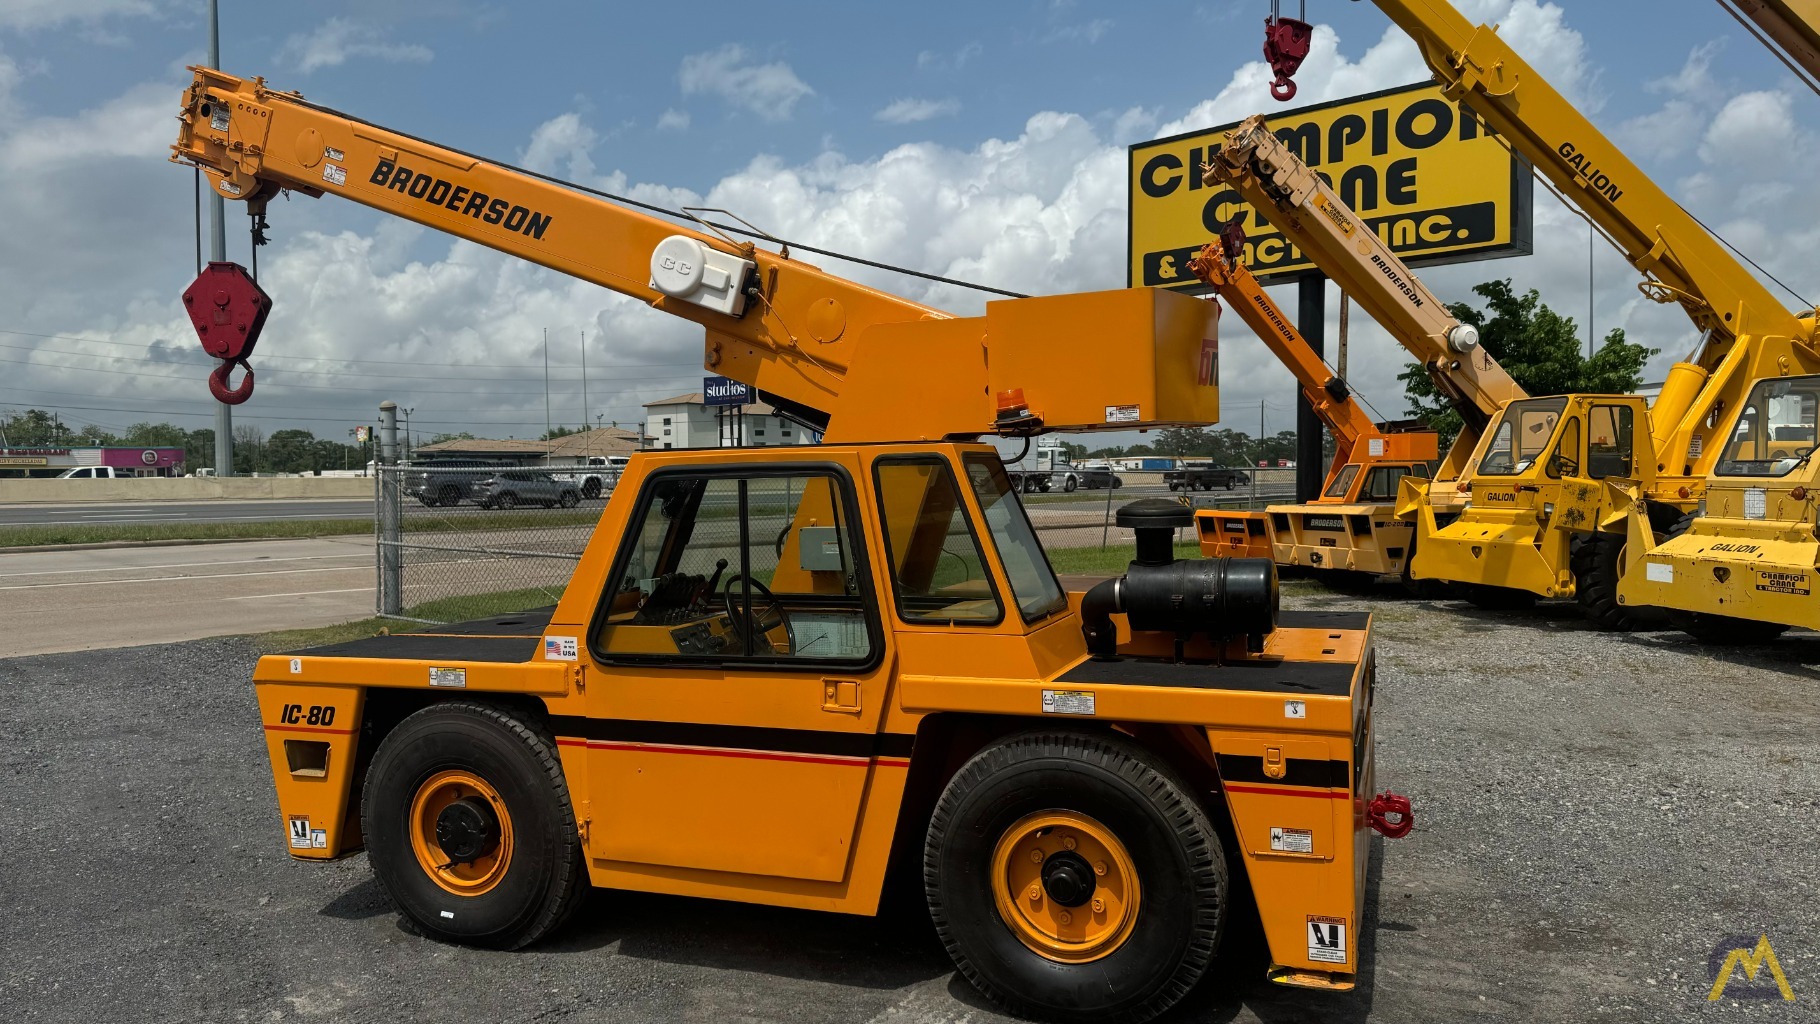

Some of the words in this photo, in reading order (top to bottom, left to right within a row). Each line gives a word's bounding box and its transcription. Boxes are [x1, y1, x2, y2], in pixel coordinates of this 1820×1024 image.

[1558, 142, 1623, 203] GALION
[369, 160, 552, 240] BRODERSON
[1158, 255, 1178, 279] &
[1370, 254, 1423, 308] BRODERSON
[1253, 294, 1295, 342] BRODERSON
[706, 380, 746, 397] studios
[1487, 492, 1516, 502] GALION
[1710, 543, 1761, 554] GALION
[1761, 572, 1805, 583] CHAMPION
[1769, 579, 1796, 588] CRANE
[280, 703, 336, 727] IC-80
[1315, 916, 1343, 924] WARNING
